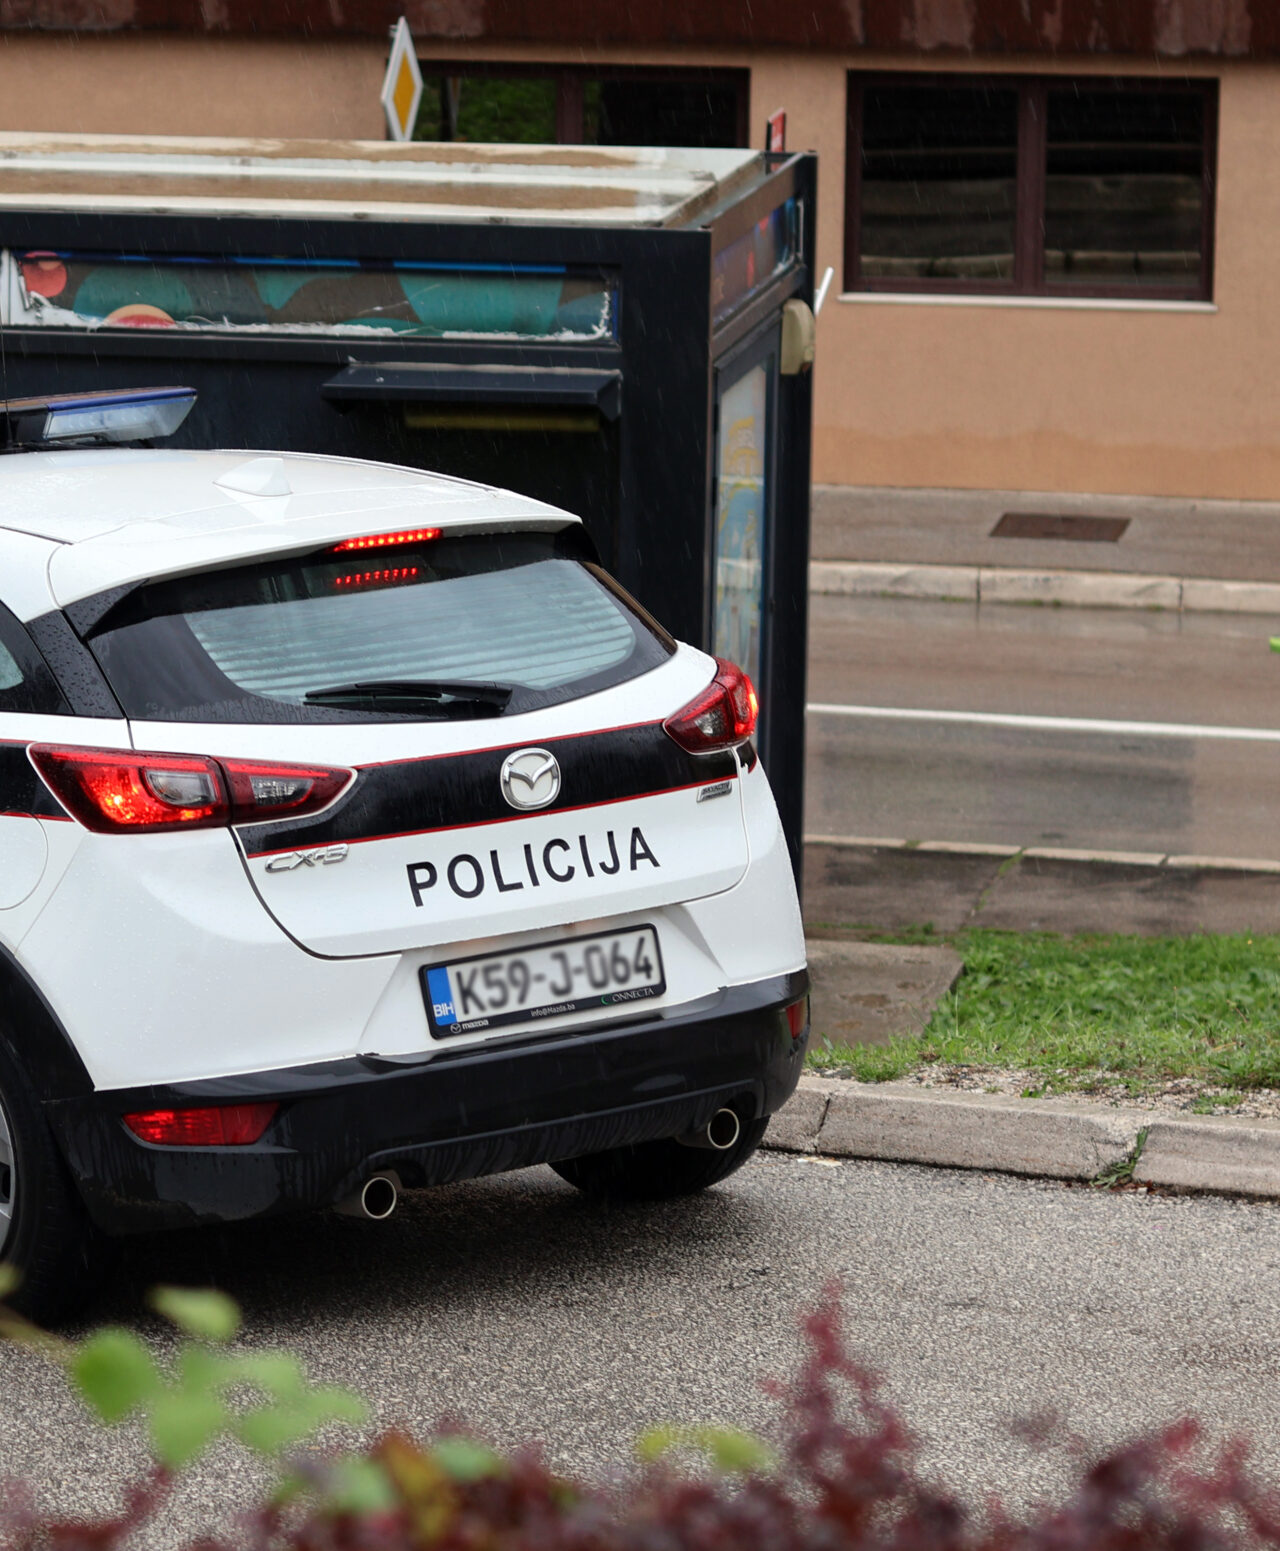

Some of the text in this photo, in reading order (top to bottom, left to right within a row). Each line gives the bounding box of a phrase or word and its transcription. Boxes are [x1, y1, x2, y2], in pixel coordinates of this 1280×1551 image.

[265, 843, 349, 874] CX-3
[406, 826, 661, 908] POLICIJA
[455, 935, 654, 1016] K59-J-064
[433, 1002, 455, 1017] BIH
[461, 1019, 489, 1030] mazda
